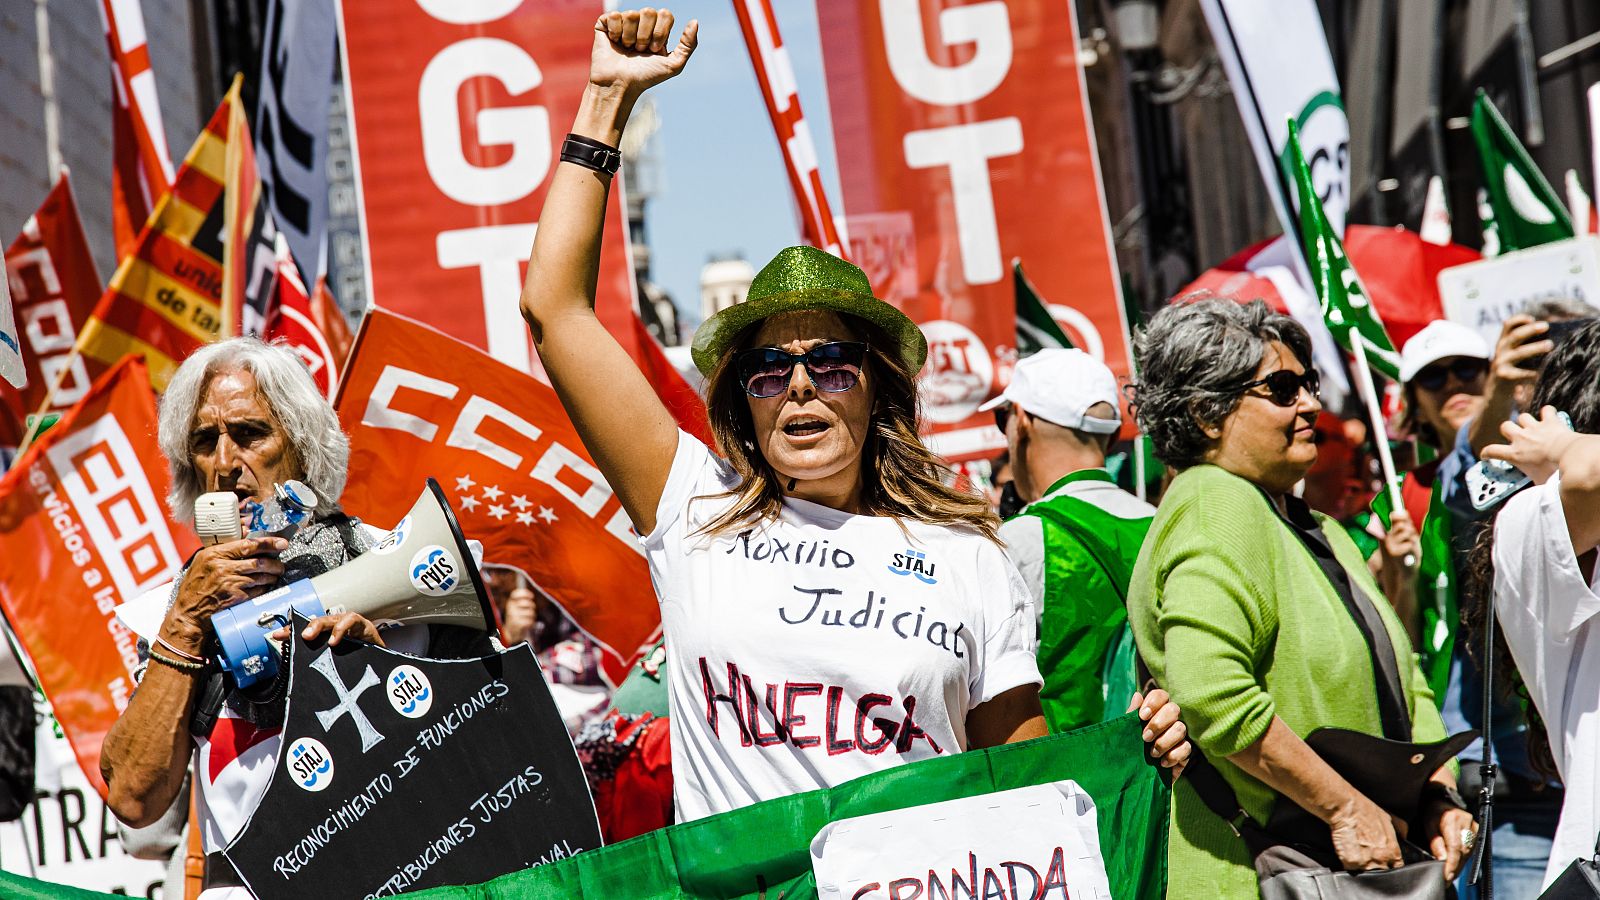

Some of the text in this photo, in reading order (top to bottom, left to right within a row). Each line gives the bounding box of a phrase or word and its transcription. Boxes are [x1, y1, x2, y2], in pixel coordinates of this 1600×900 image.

[410, 0, 553, 373] GT
[8, 214, 92, 402] COO
[156, 286, 187, 315] de
[68, 436, 171, 588] CCO
[82, 567, 103, 588] a
[420, 556, 454, 591] STAJ
[892, 552, 936, 578] STAJ
[92, 585, 116, 616] la
[778, 585, 965, 659] Judicial
[392, 677, 424, 706] STAJ
[698, 656, 943, 757] HUELGA
[272, 678, 510, 881] RECONOCIMIENTO DE FUNCIONES
[292, 745, 324, 780] STAJ
[469, 765, 544, 824] JUSTAS
